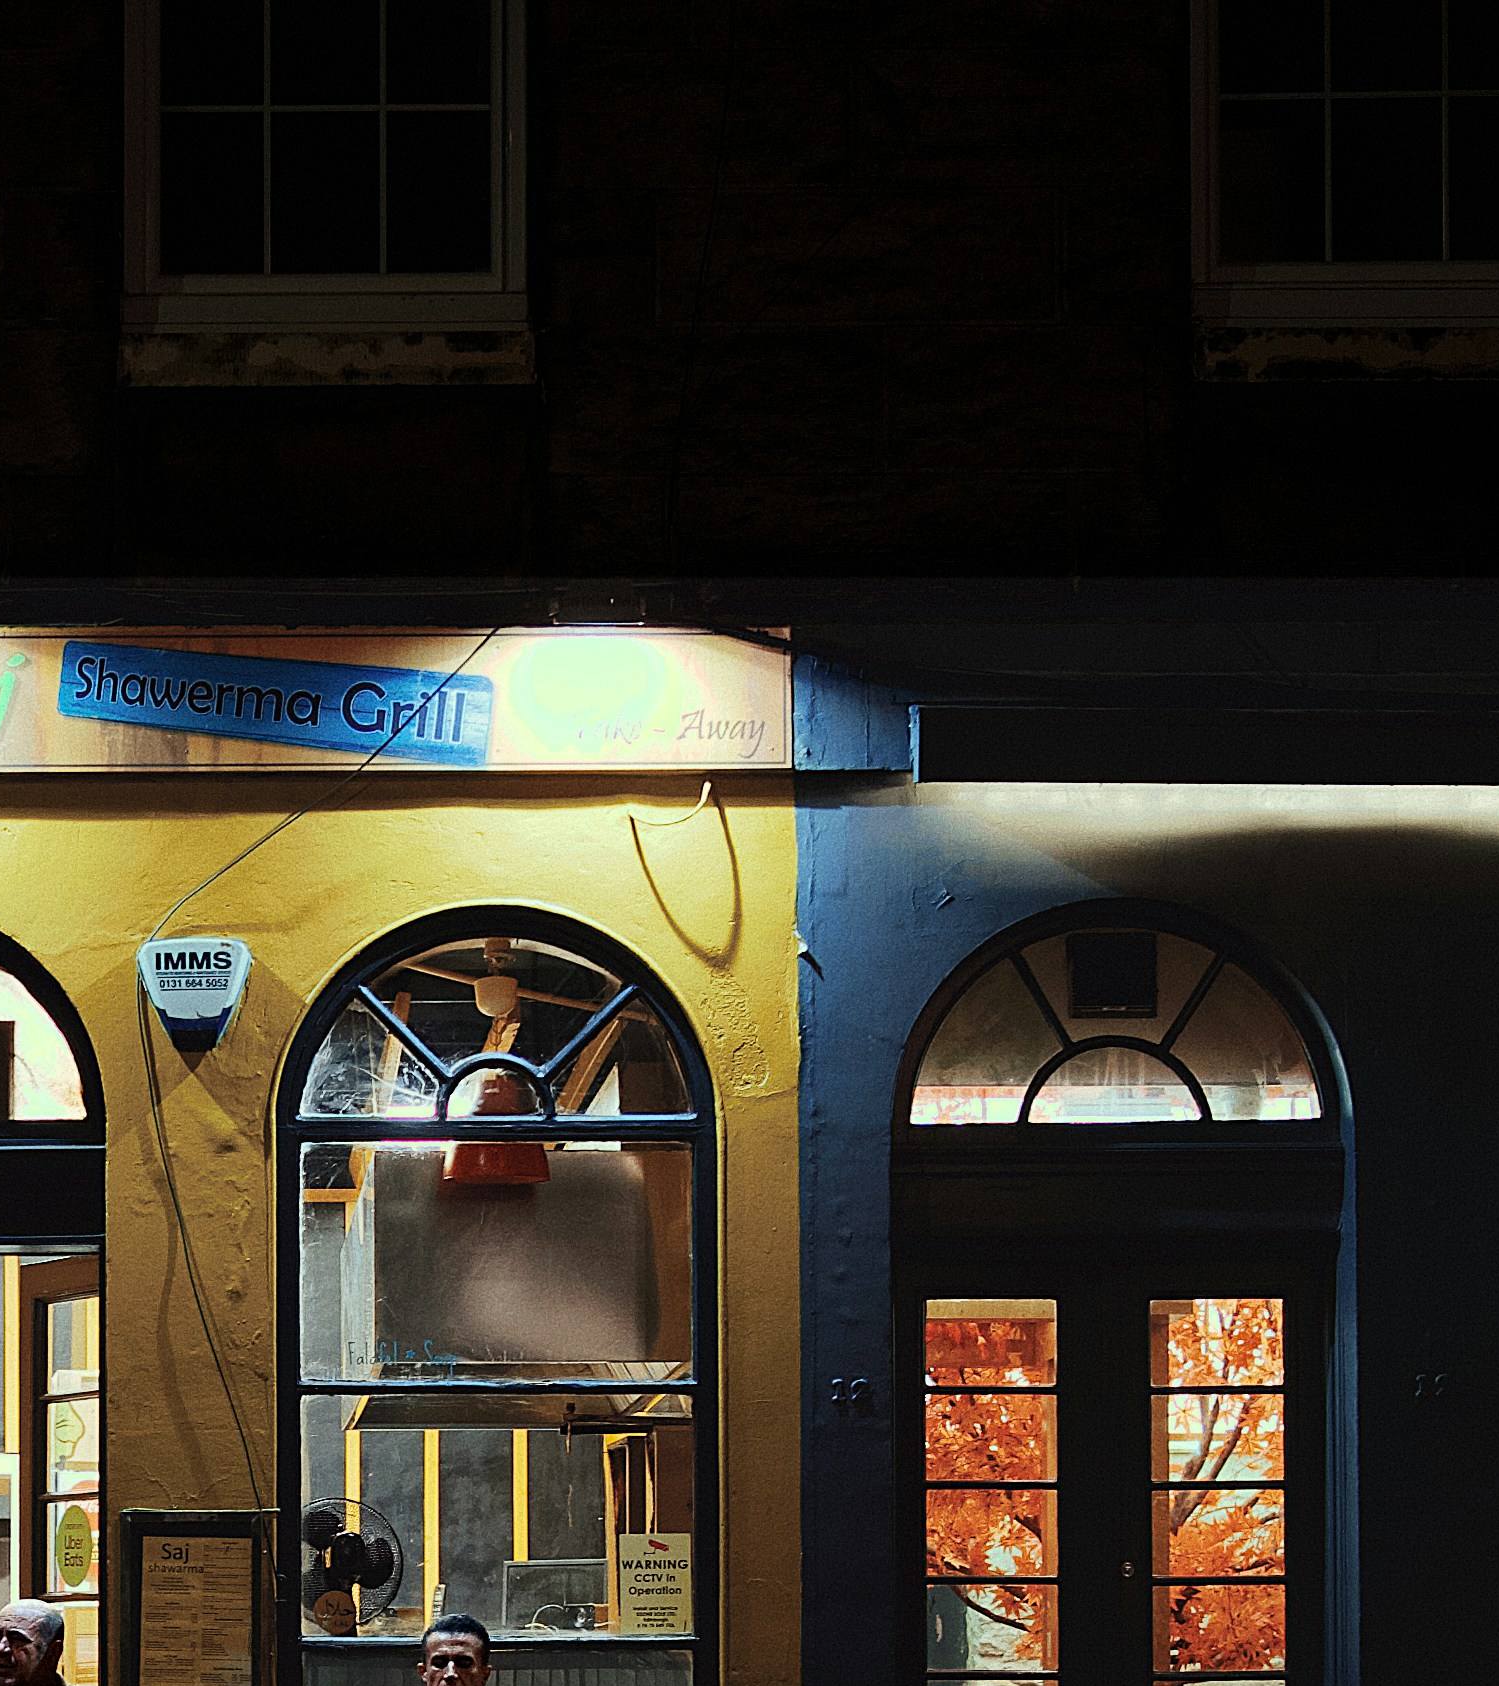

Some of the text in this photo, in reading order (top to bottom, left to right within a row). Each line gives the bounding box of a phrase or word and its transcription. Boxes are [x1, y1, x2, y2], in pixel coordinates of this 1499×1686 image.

[73, 655, 466, 745] Shawerma Grill
[676, 708, 767, 759] Away
[155, 951, 232, 971] IMMS
[159, 979, 182, 988] 0131
[63, 1535, 84, 1550] Uber
[63, 1552, 84, 1567] Eats
[160, 1542, 190, 1564] Saj
[147, 1562, 205, 1574] shawarma
[621, 1559, 689, 1570] WARNING
[634, 1573, 664, 1583] CCTV
[628, 1585, 682, 1597] Operation
